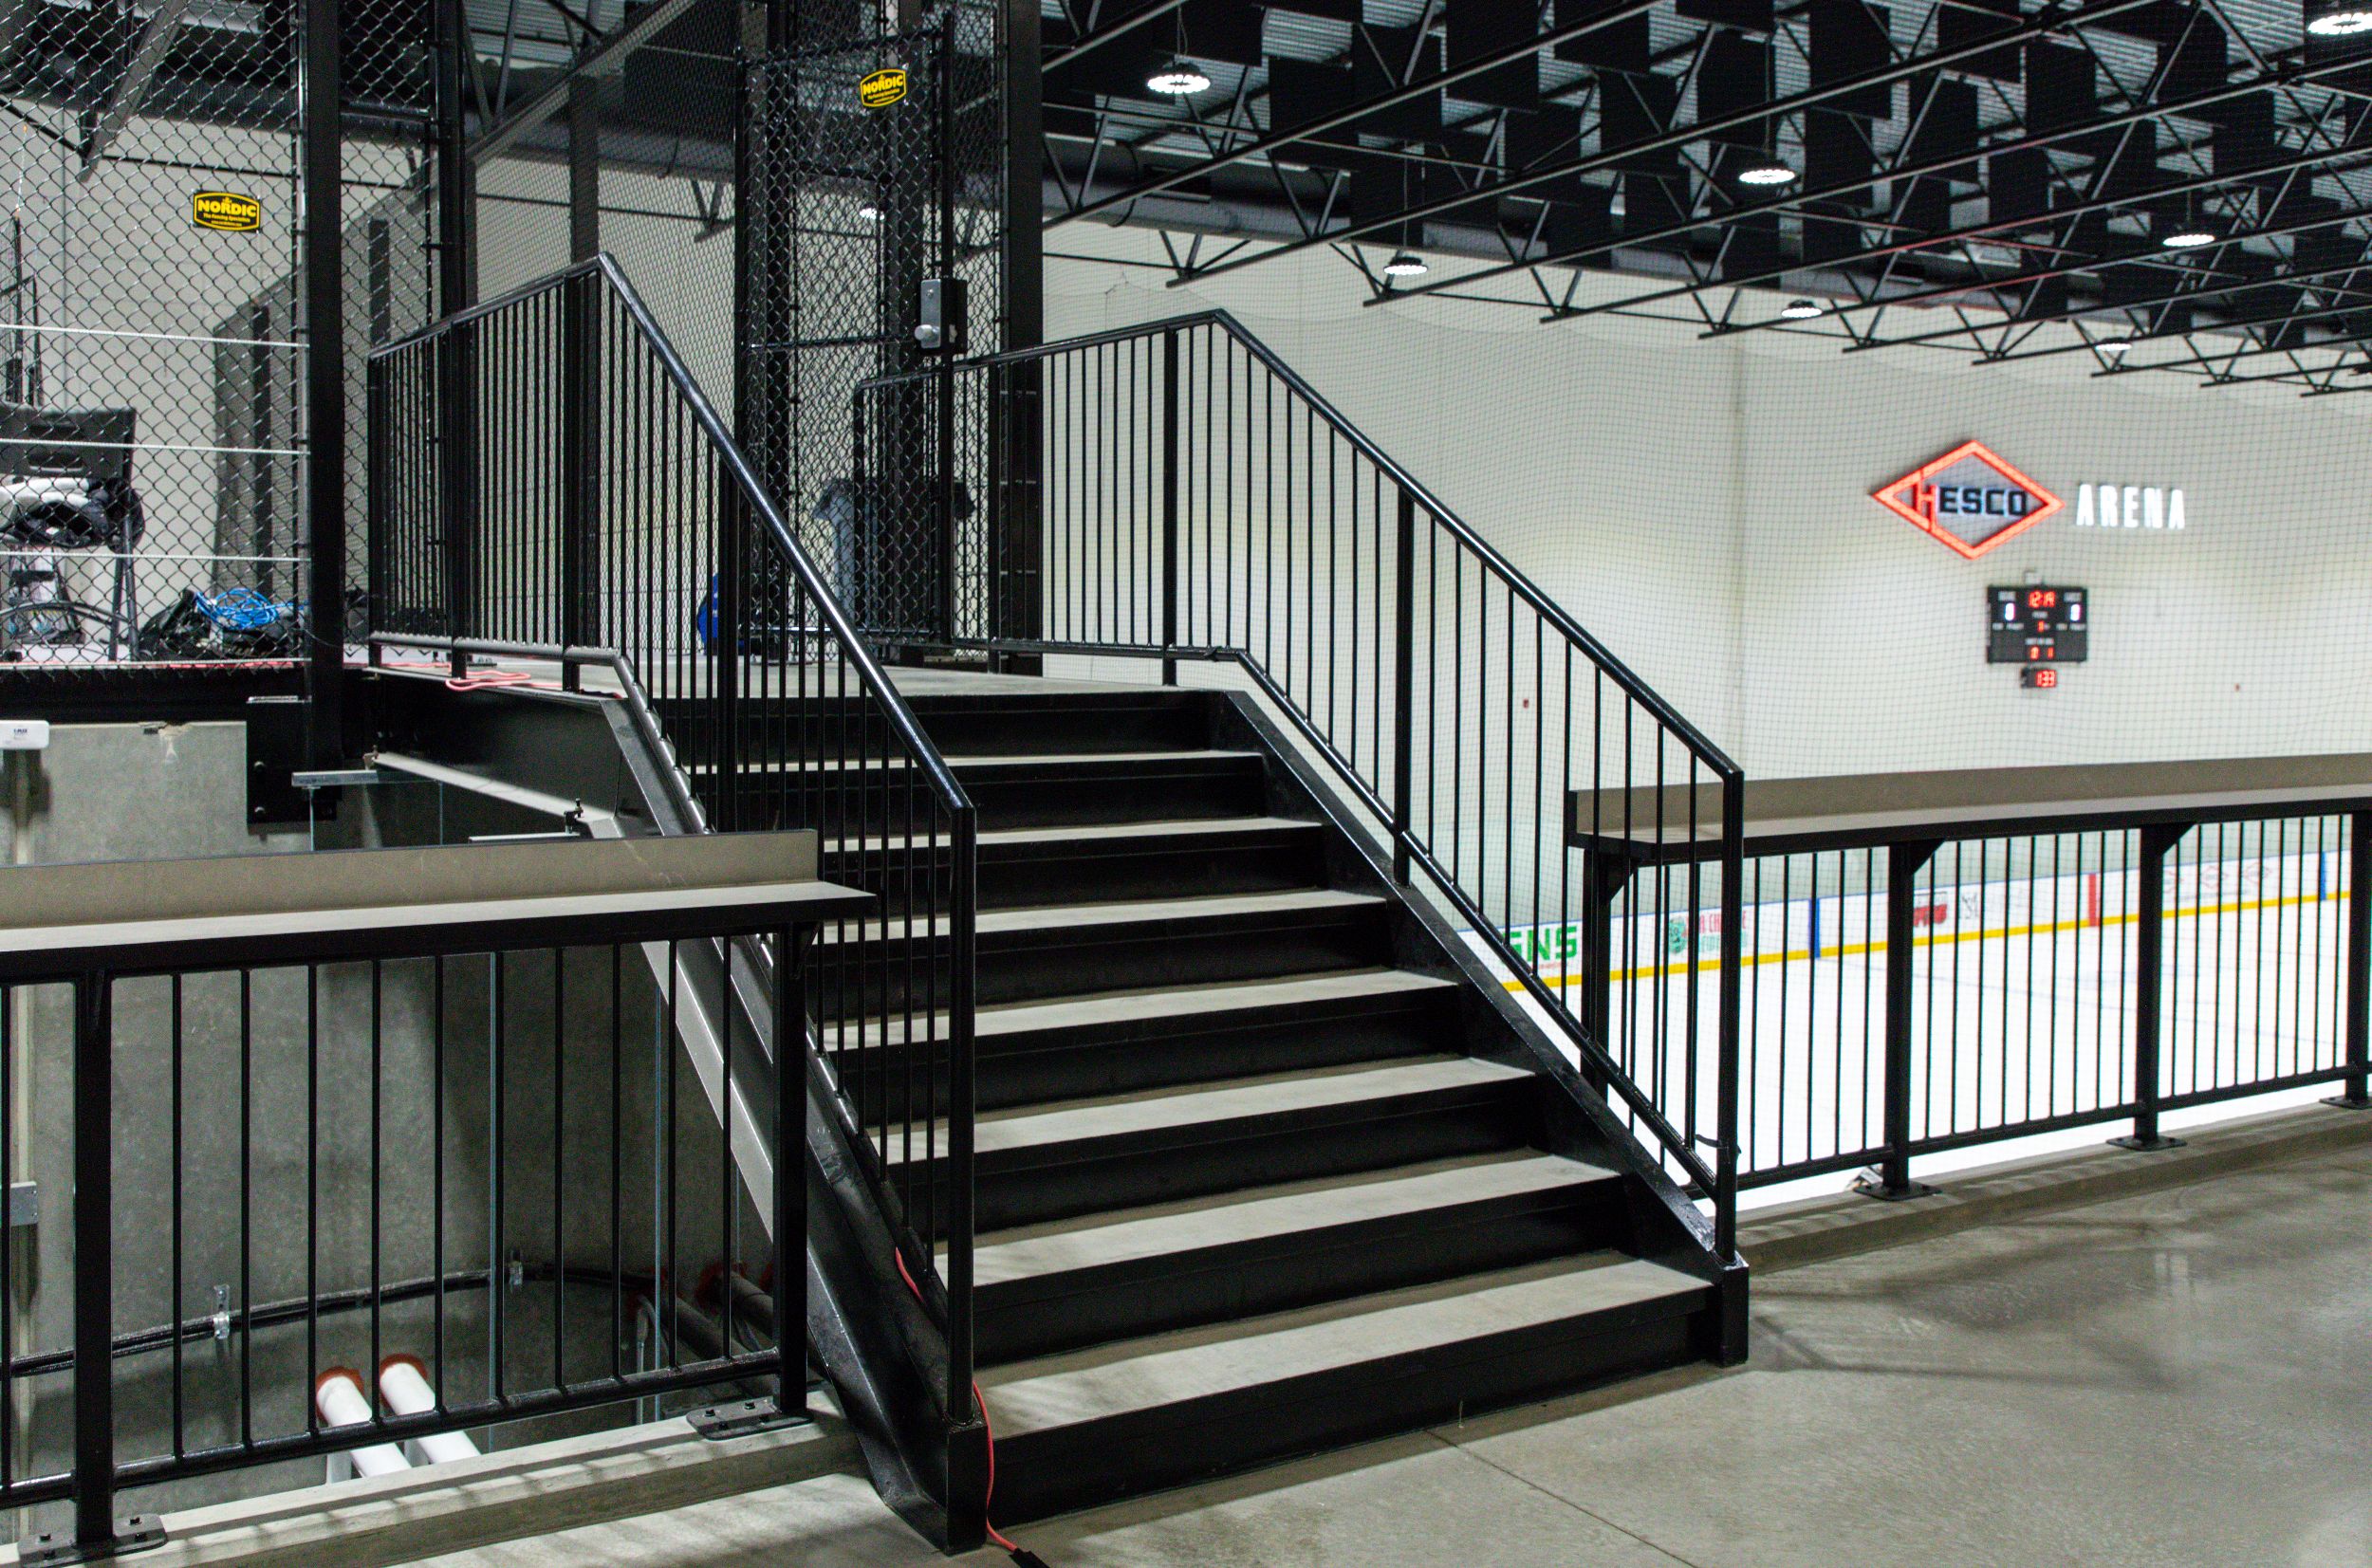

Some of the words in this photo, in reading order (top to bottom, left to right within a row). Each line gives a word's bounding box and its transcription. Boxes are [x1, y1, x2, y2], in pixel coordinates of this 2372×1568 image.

[862, 75, 903, 96] NORDIC
[197, 199, 257, 217] NORDIC
[1915, 476, 2028, 522] HESCO
[2076, 484, 2185, 530] ARENA
